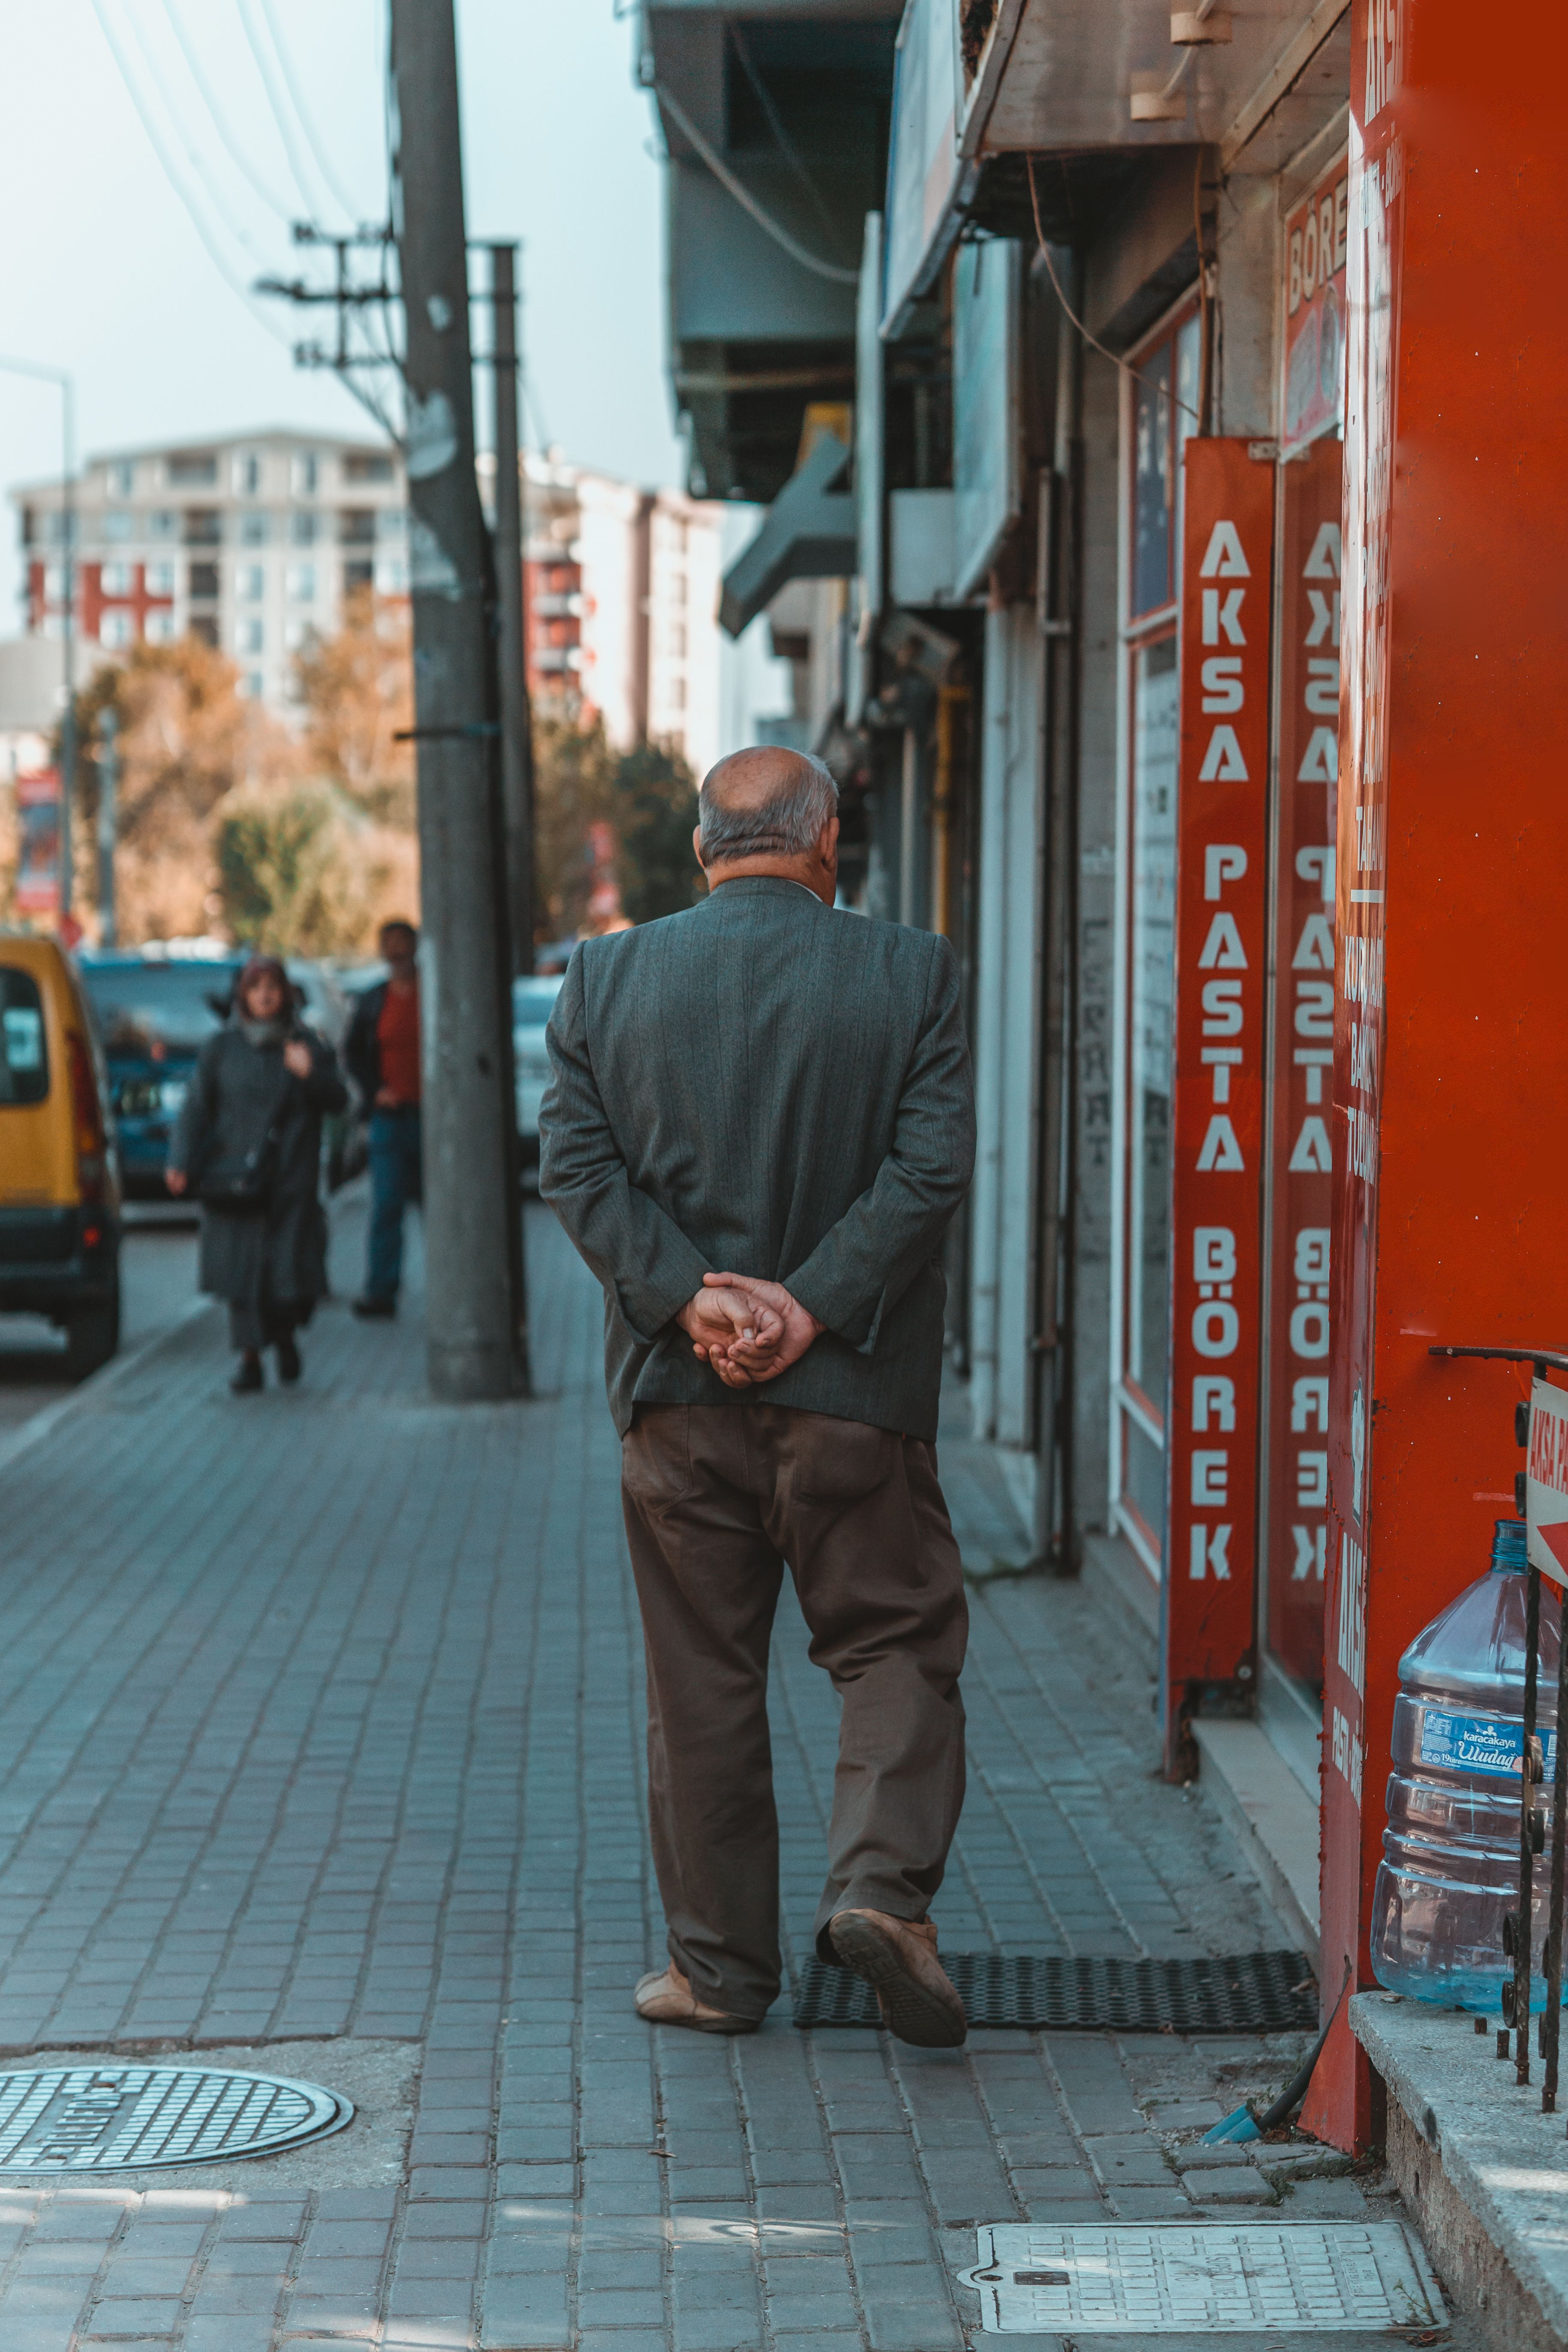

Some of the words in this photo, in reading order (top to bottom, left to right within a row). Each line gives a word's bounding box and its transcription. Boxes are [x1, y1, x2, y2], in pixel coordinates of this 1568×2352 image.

[1199, 520, 1251, 782] AKSA
[1196, 844, 1248, 1172] PASTA
[1190, 1226, 1239, 1580] BÖREK
[1529, 1407, 1556, 1488] AKSA
[1458, 1741, 1515, 1771] Uludağ
[1464, 1731, 1516, 1749] karacakaya
